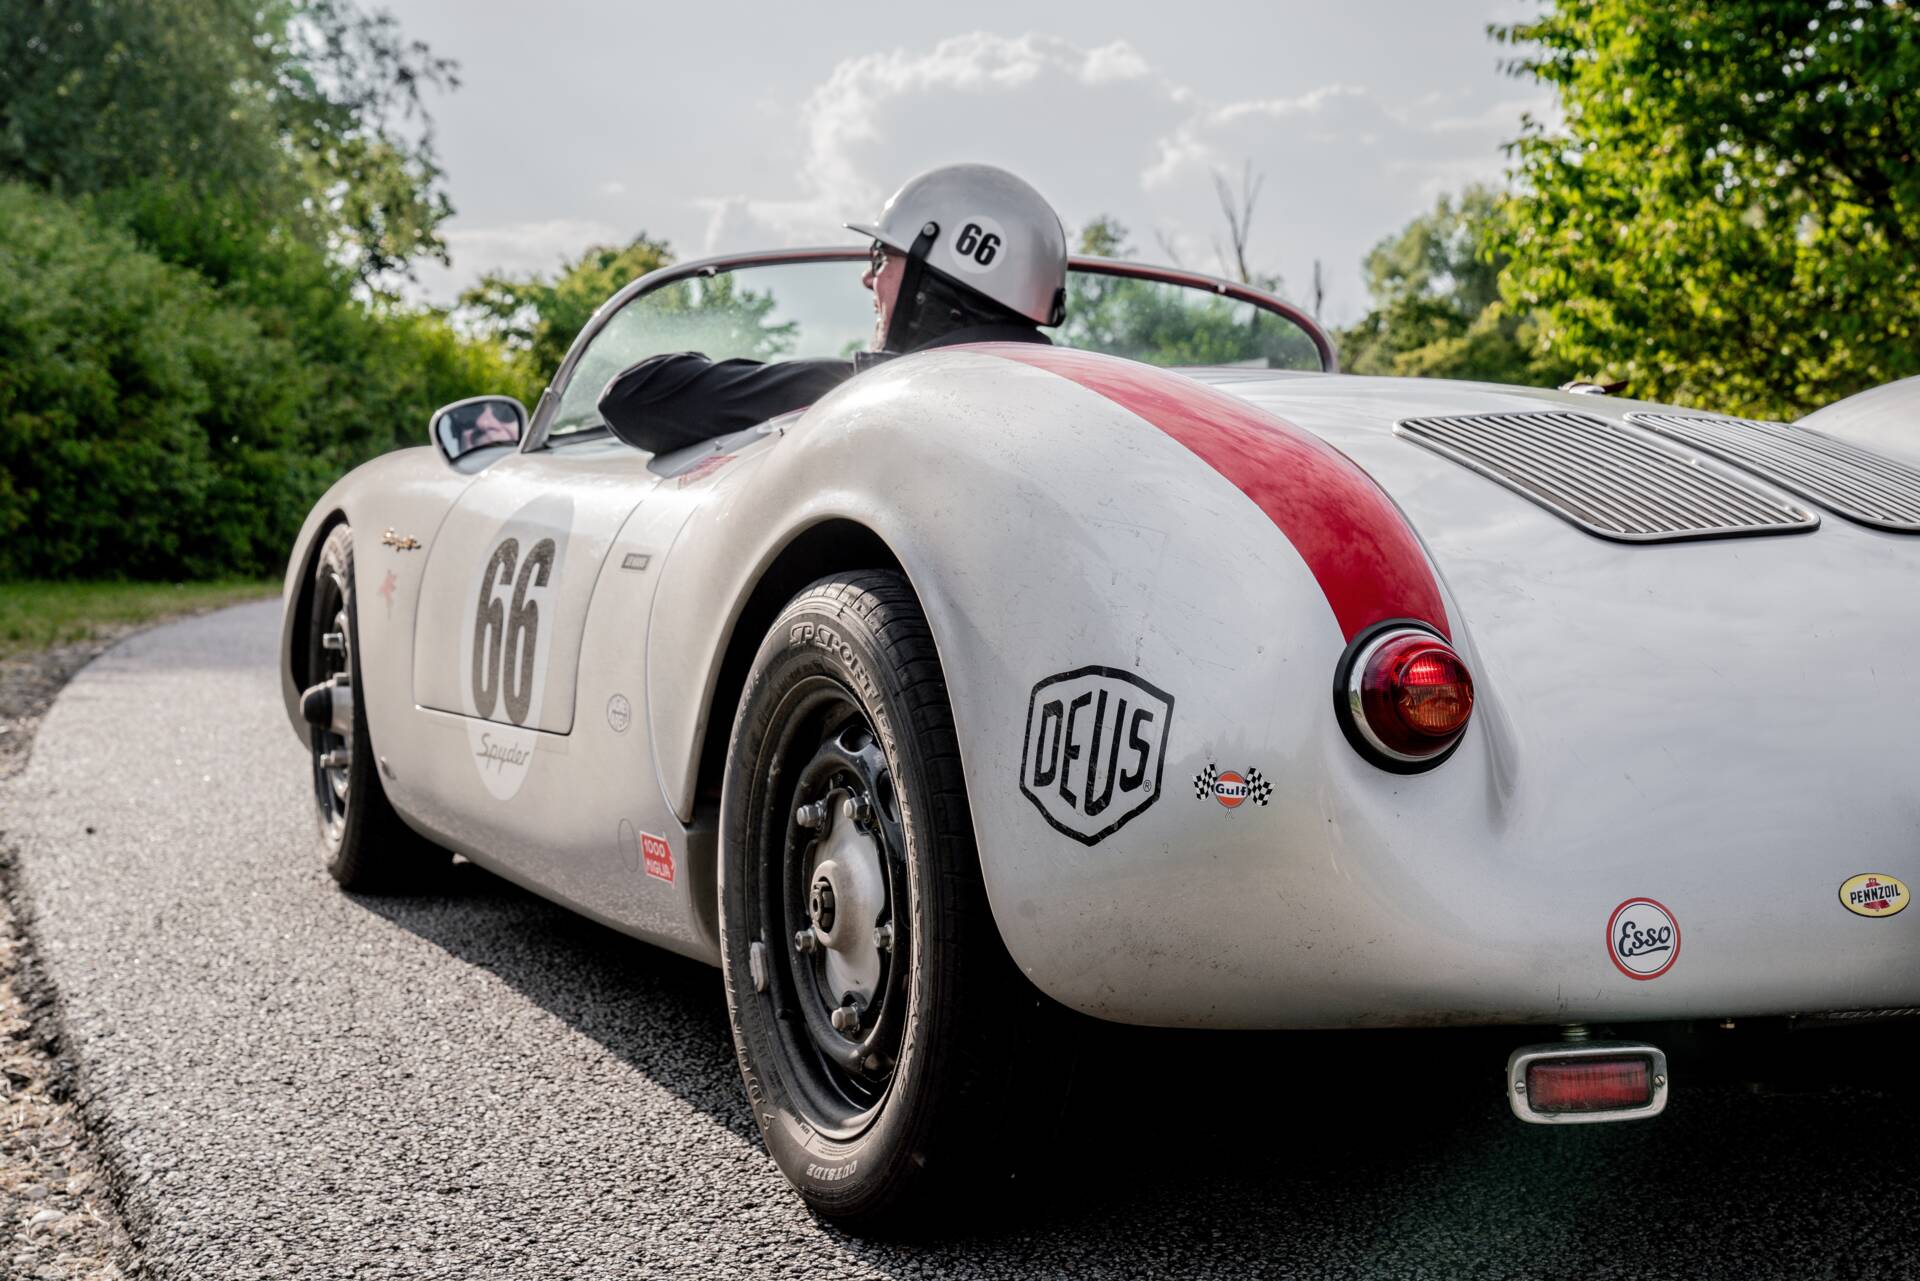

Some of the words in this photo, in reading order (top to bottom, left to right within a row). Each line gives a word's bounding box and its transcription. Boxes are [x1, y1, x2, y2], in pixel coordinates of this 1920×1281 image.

[955, 223, 1001, 266] 66
[471, 537, 556, 726] 66
[476, 732, 530, 776] Spyder
[1034, 689, 1154, 816] DEUS
[1215, 783, 1247, 796] Gulf
[643, 839, 665, 858] 1000
[1850, 884, 1901, 904] PENNZOIL
[1618, 921, 1671, 957] Esso
[806, 1159, 858, 1181] OUTSIDE
